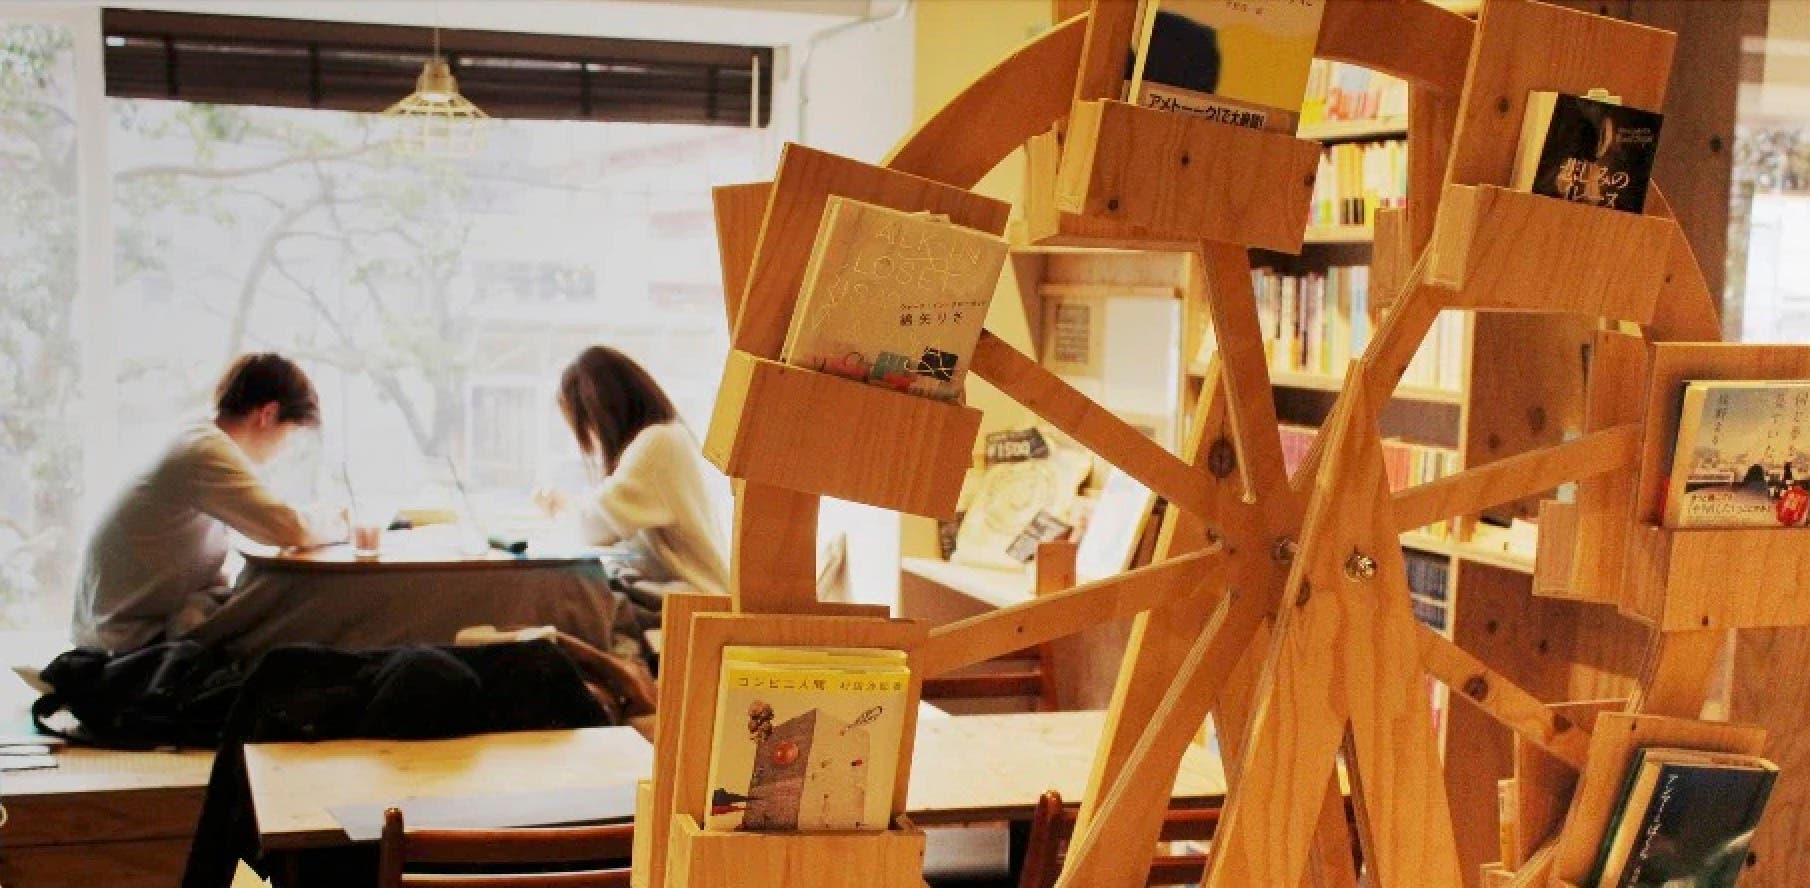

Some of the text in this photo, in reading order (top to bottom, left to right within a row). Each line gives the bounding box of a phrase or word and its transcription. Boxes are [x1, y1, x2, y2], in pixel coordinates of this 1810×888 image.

[737, 677, 827, 691] コンビニ人間
